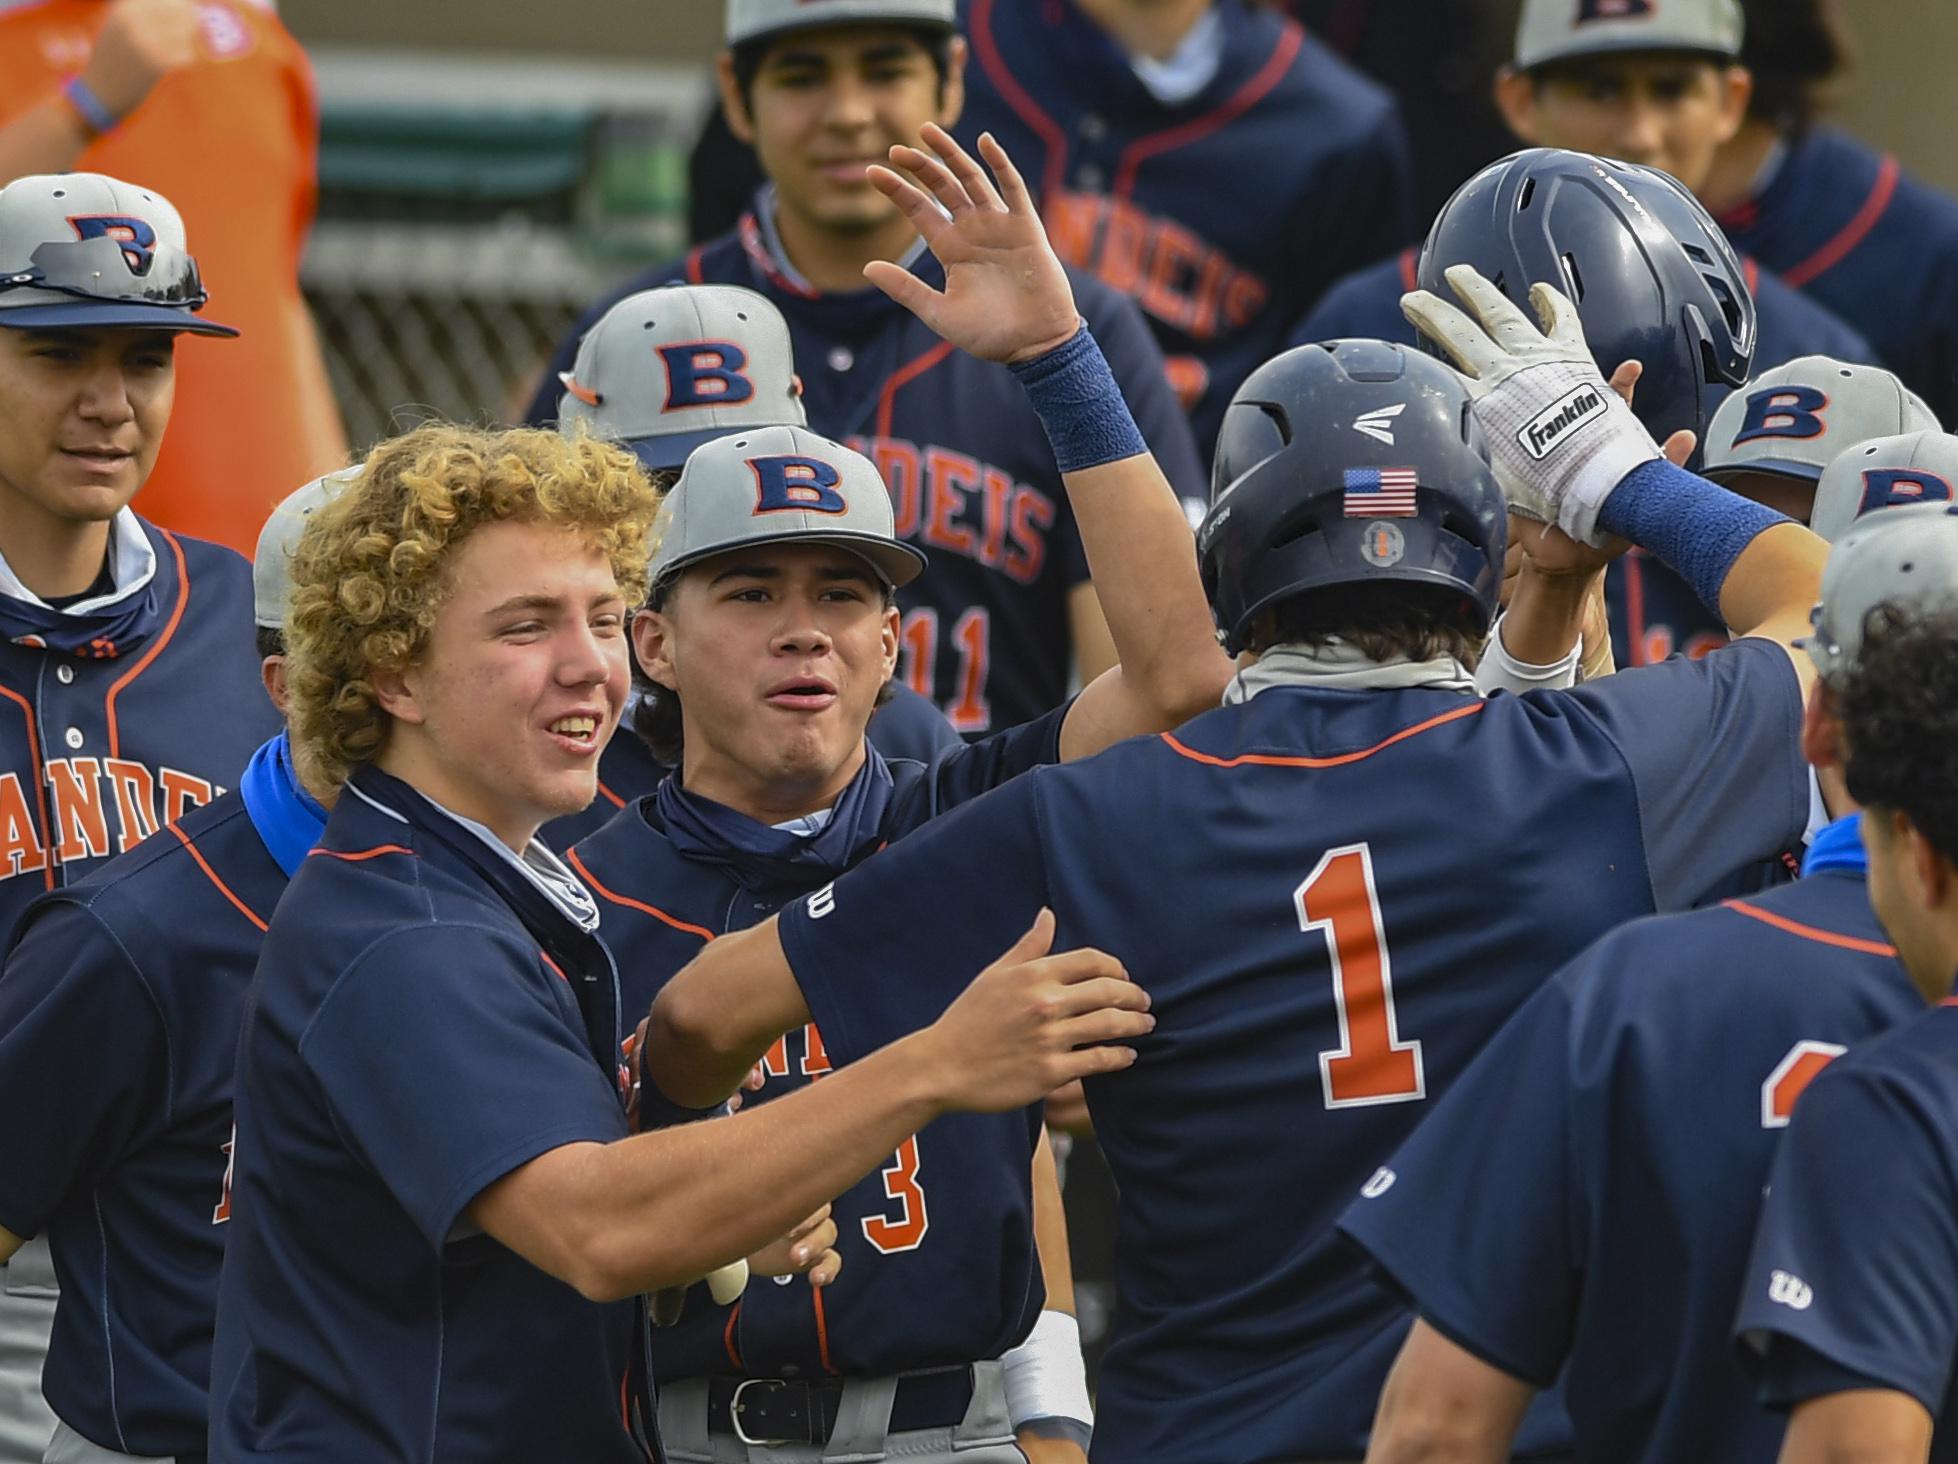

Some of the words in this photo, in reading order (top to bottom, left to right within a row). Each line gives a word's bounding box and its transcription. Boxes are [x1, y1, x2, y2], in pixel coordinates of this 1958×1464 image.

[655, 338, 757, 414] B
[1527, 392, 1599, 456] Franklin
[1730, 384, 1830, 451] B
[744, 453, 848, 516] B
[840, 434, 1056, 584] DEIS
[900, 606, 991, 732] 11
[0, 757, 229, 881] ANDE
[1293, 842, 1426, 1110] 1
[861, 1133, 928, 1254] 3
